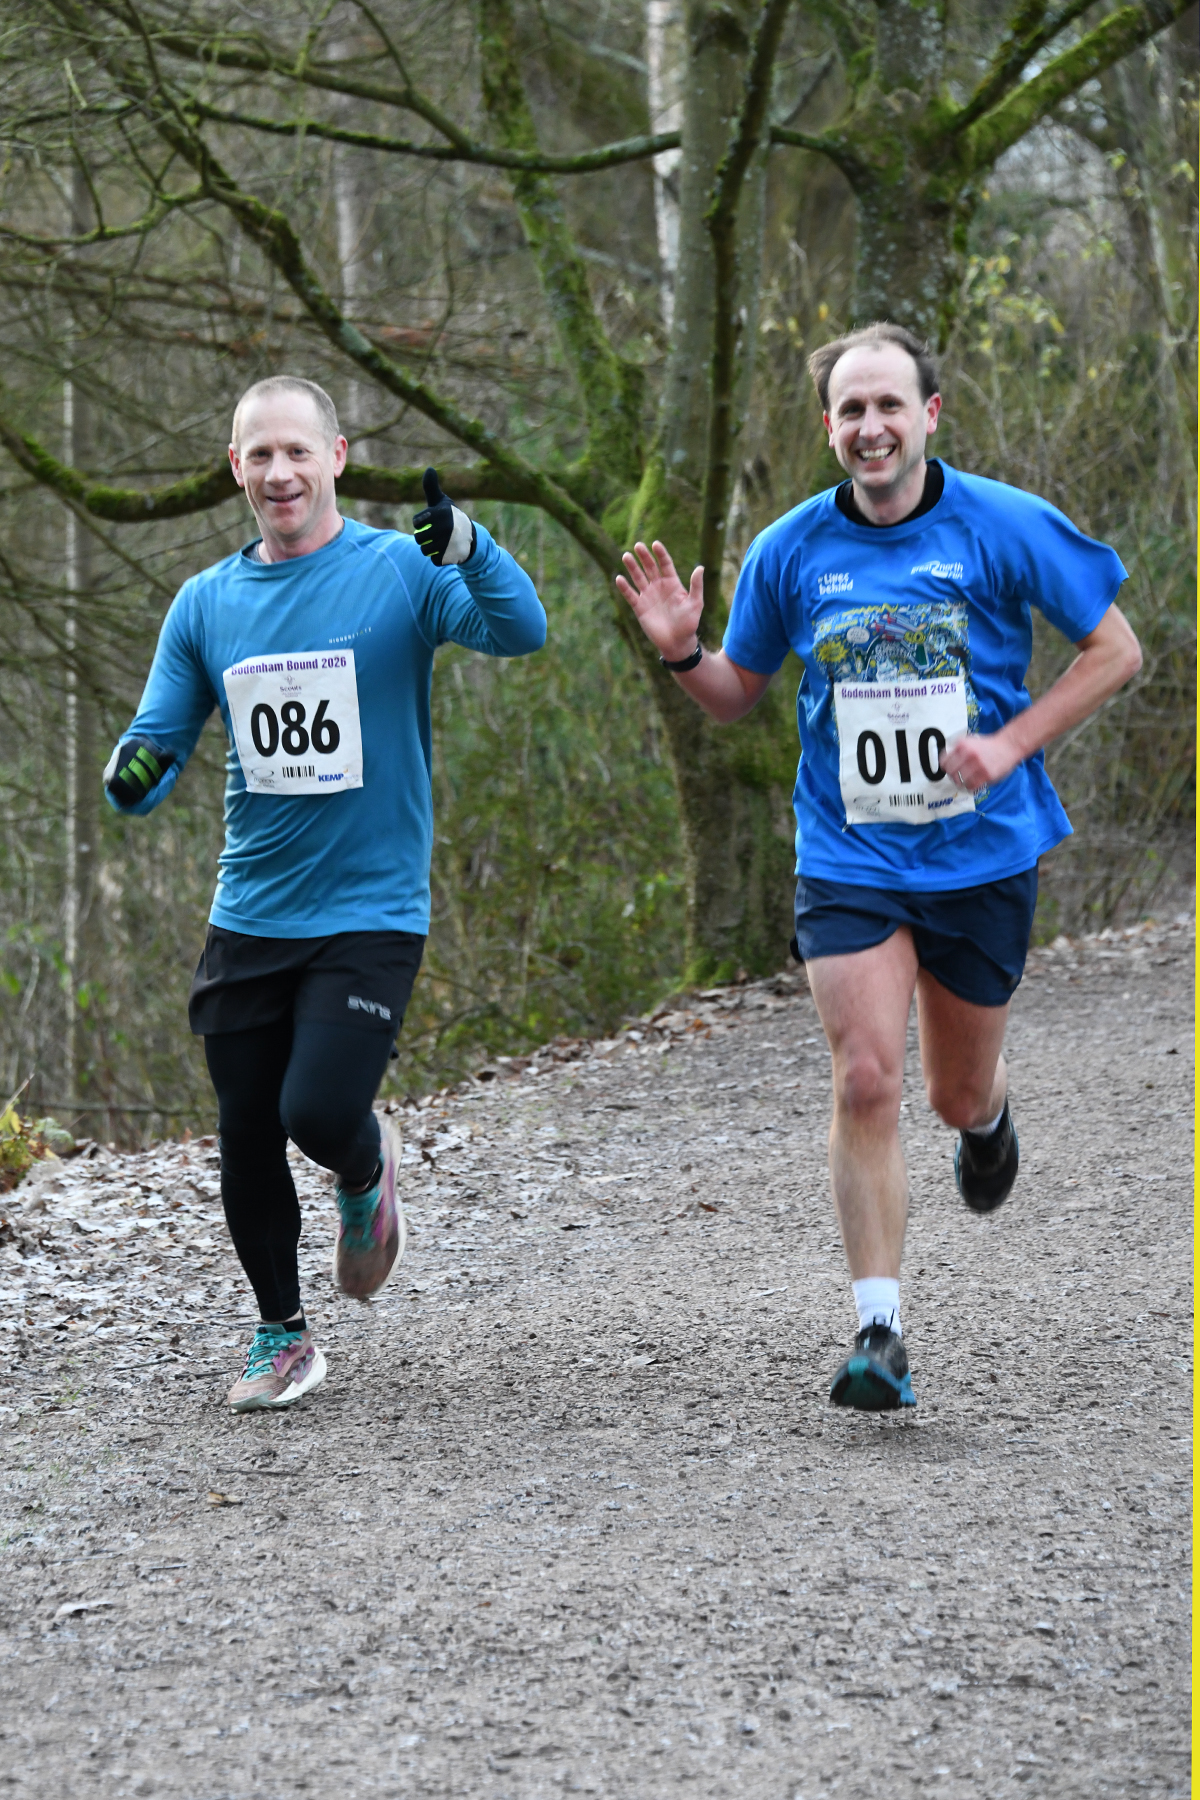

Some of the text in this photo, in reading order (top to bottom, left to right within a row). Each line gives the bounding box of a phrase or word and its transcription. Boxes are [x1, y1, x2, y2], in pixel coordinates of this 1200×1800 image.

[819, 579, 854, 595] behind
[231, 656, 347, 676] Bodenham Bound 2026
[841, 686, 891, 699] Bodenham
[894, 685, 927, 698] Bound
[250, 699, 341, 758] 086
[856, 727, 947, 786] 010
[318, 773, 344, 783] KEMP
